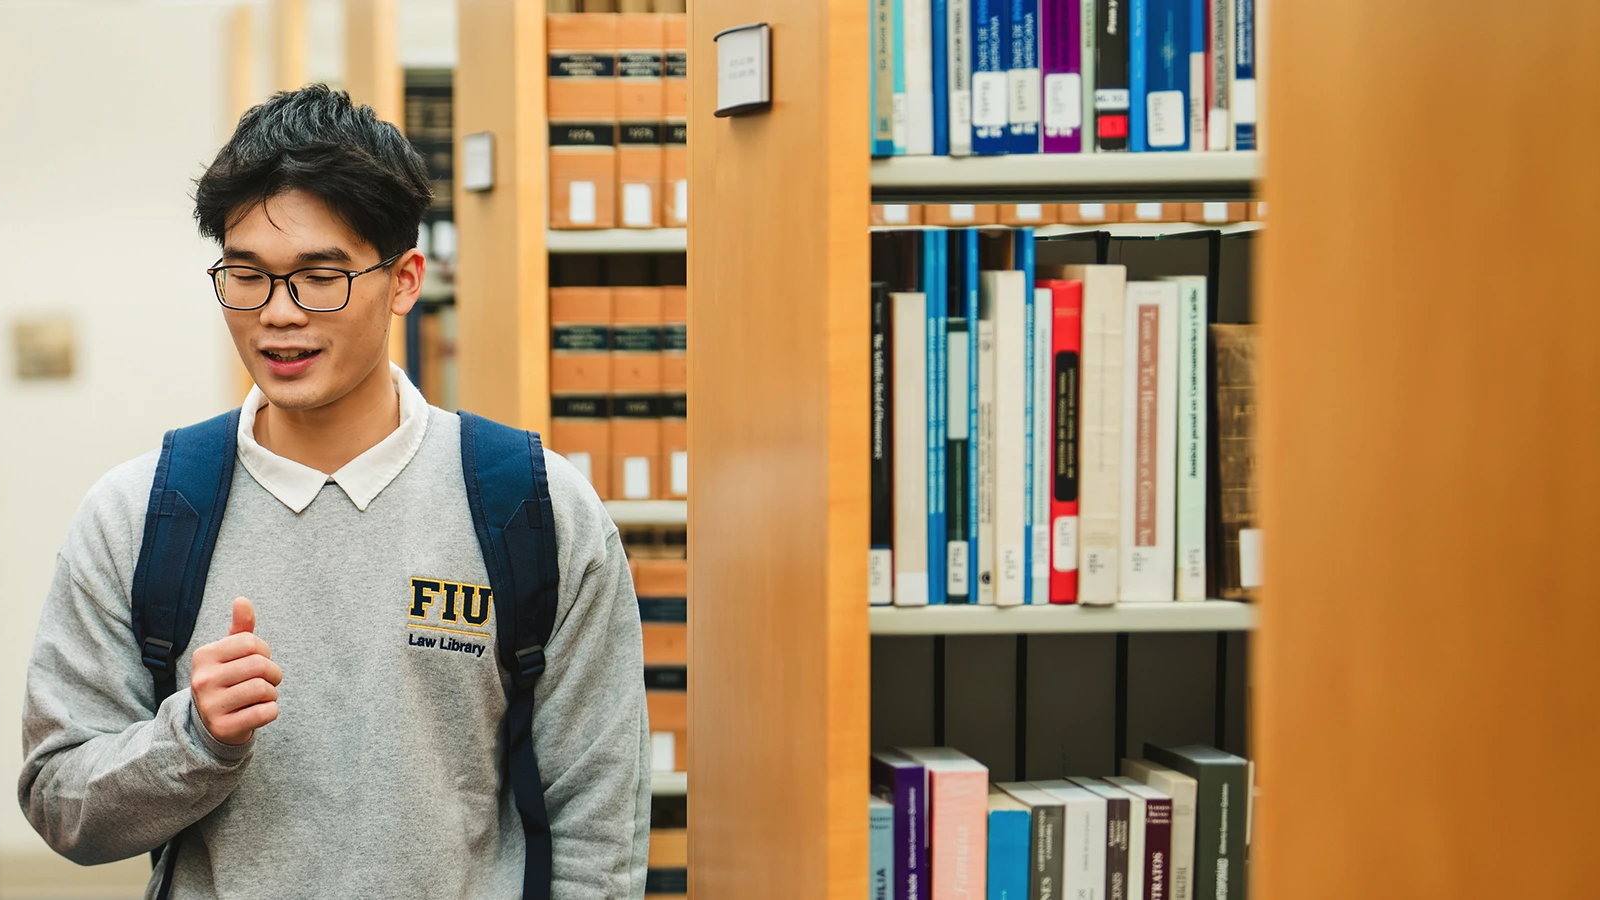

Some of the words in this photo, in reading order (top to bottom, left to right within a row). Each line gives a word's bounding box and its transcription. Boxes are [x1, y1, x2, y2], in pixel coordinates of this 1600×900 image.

[408, 576, 493, 627] FIU
[408, 633, 437, 648] Law
[439, 637, 486, 658] Library
